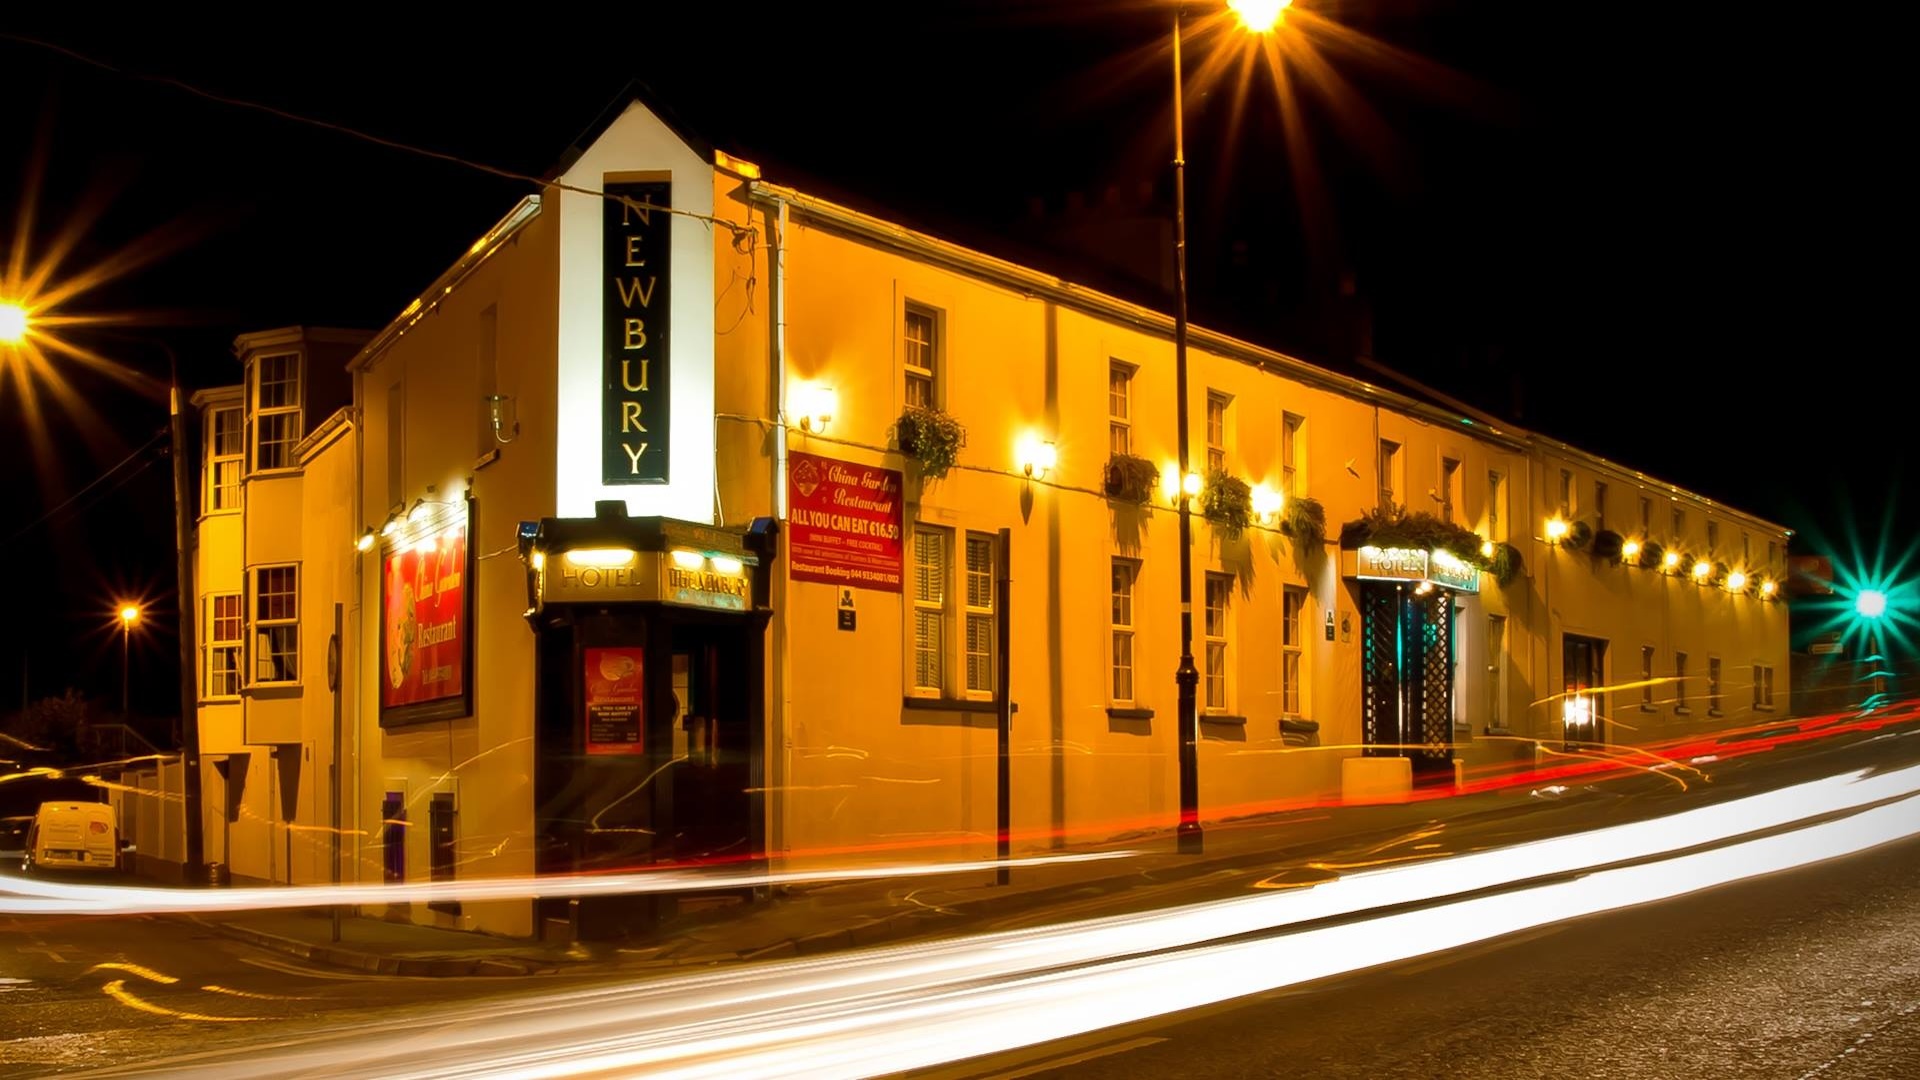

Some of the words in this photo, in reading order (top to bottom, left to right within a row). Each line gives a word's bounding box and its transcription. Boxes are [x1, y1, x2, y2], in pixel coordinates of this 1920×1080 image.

[615, 194, 656, 475] NEWBURY
[828, 465, 858, 486] China
[833, 488, 892, 514] Restaurant
[791, 508, 809, 526] ALL
[810, 511, 829, 529] YOU
[831, 514, 850, 532] CAN
[852, 518, 868, 534] EAT
[869, 521, 899, 539] €16.50
[561, 566, 641, 588] HOTEL
[791, 560, 825, 574] Restaurant
[825, 565, 850, 580] Booking
[418, 613, 457, 649] Restaurant
